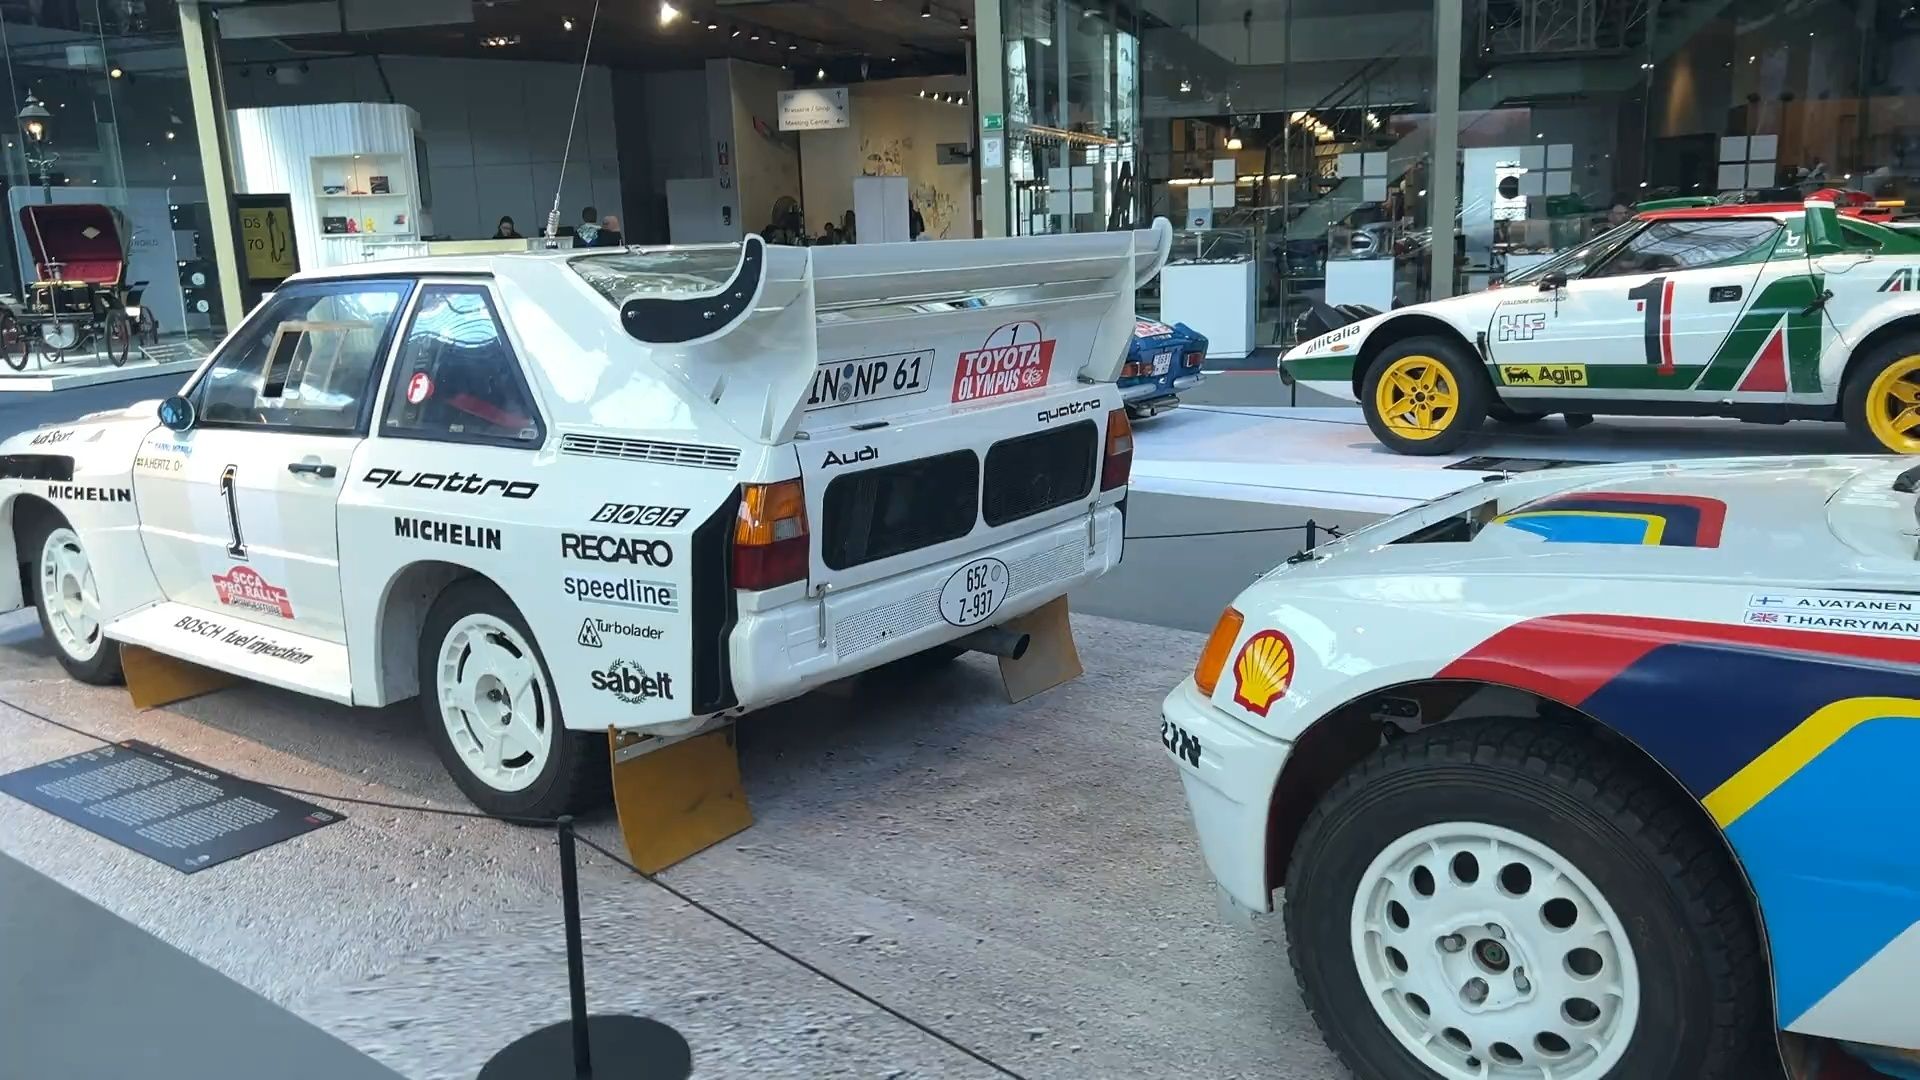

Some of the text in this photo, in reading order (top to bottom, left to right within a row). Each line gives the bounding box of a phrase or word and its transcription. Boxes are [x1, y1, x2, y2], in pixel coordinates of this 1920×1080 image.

[244, 218, 261, 229] DS
[1010, 324, 1020, 346] 1
[1498, 312, 1546, 342] HF
[1628, 277, 1674, 370] 1
[964, 344, 1041, 374] TOYOTA
[853, 361, 888, 398] NP
[893, 356, 922, 389] 61
[957, 368, 1021, 401] OLYMPUS
[1538, 366, 1583, 384] Agip
[1037, 398, 1100, 423] quattro
[821, 445, 879, 469] Audi
[48, 485, 131, 502] MICHELIN
[363, 468, 539, 499] quattro
[220, 463, 249, 562] 1
[592, 503, 688, 527] BOGE
[394, 516, 501, 551] MICHELIN
[561, 533, 673, 567] RECARO
[220, 580, 281, 604] PRO RALLY
[231, 571, 263, 587] SCCA
[564, 576, 672, 606] speedline
[966, 564, 988, 592] 652
[958, 589, 993, 623] Z-937
[1797, 598, 1912, 611] A.VATANEN
[595, 618, 664, 640] Turbolader
[1784, 615, 1920, 633] T.HARRYMAN
[174, 615, 314, 664] BOSCH fuel injection
[591, 667, 674, 700] sabelt
